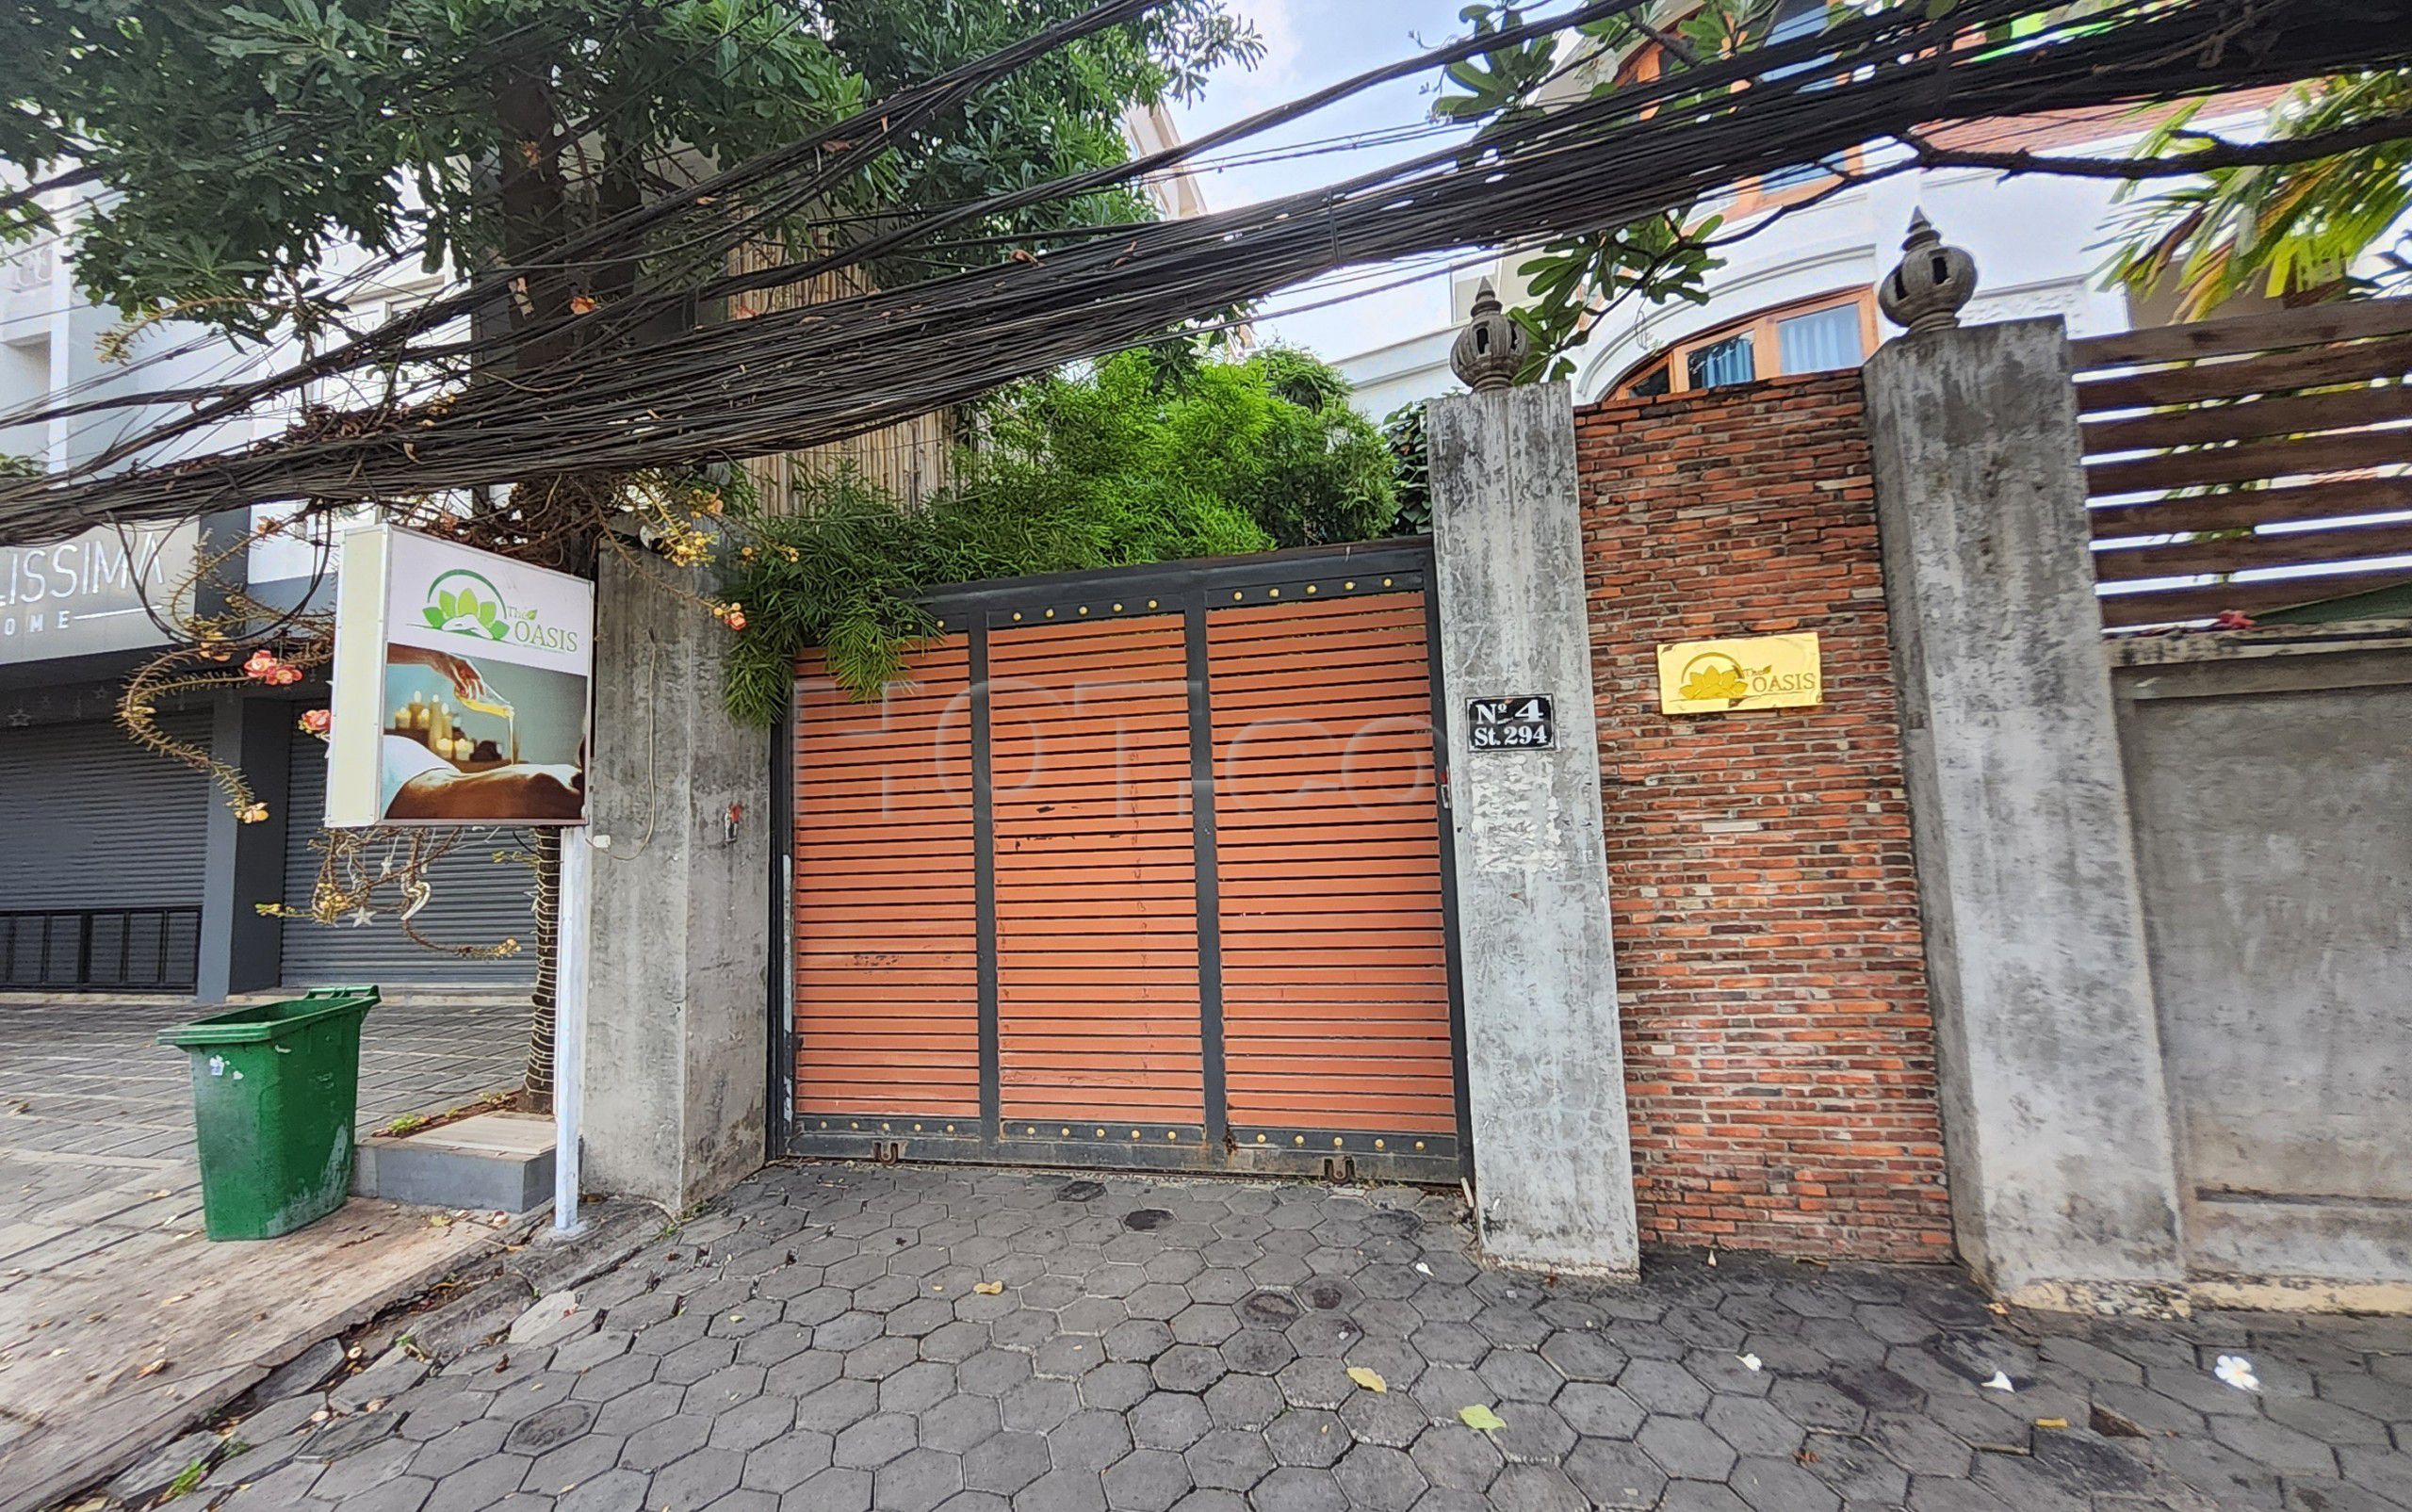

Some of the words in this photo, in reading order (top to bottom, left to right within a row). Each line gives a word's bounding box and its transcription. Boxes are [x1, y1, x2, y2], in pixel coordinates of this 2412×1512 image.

[0, 532, 164, 608] ISSIMA
[514, 621, 578, 652] OASIS
[1752, 673, 1816, 692] OASIS
[1515, 699, 1544, 723] 4
[1475, 726, 1501, 746] St.
[1504, 724, 1547, 745] 294
